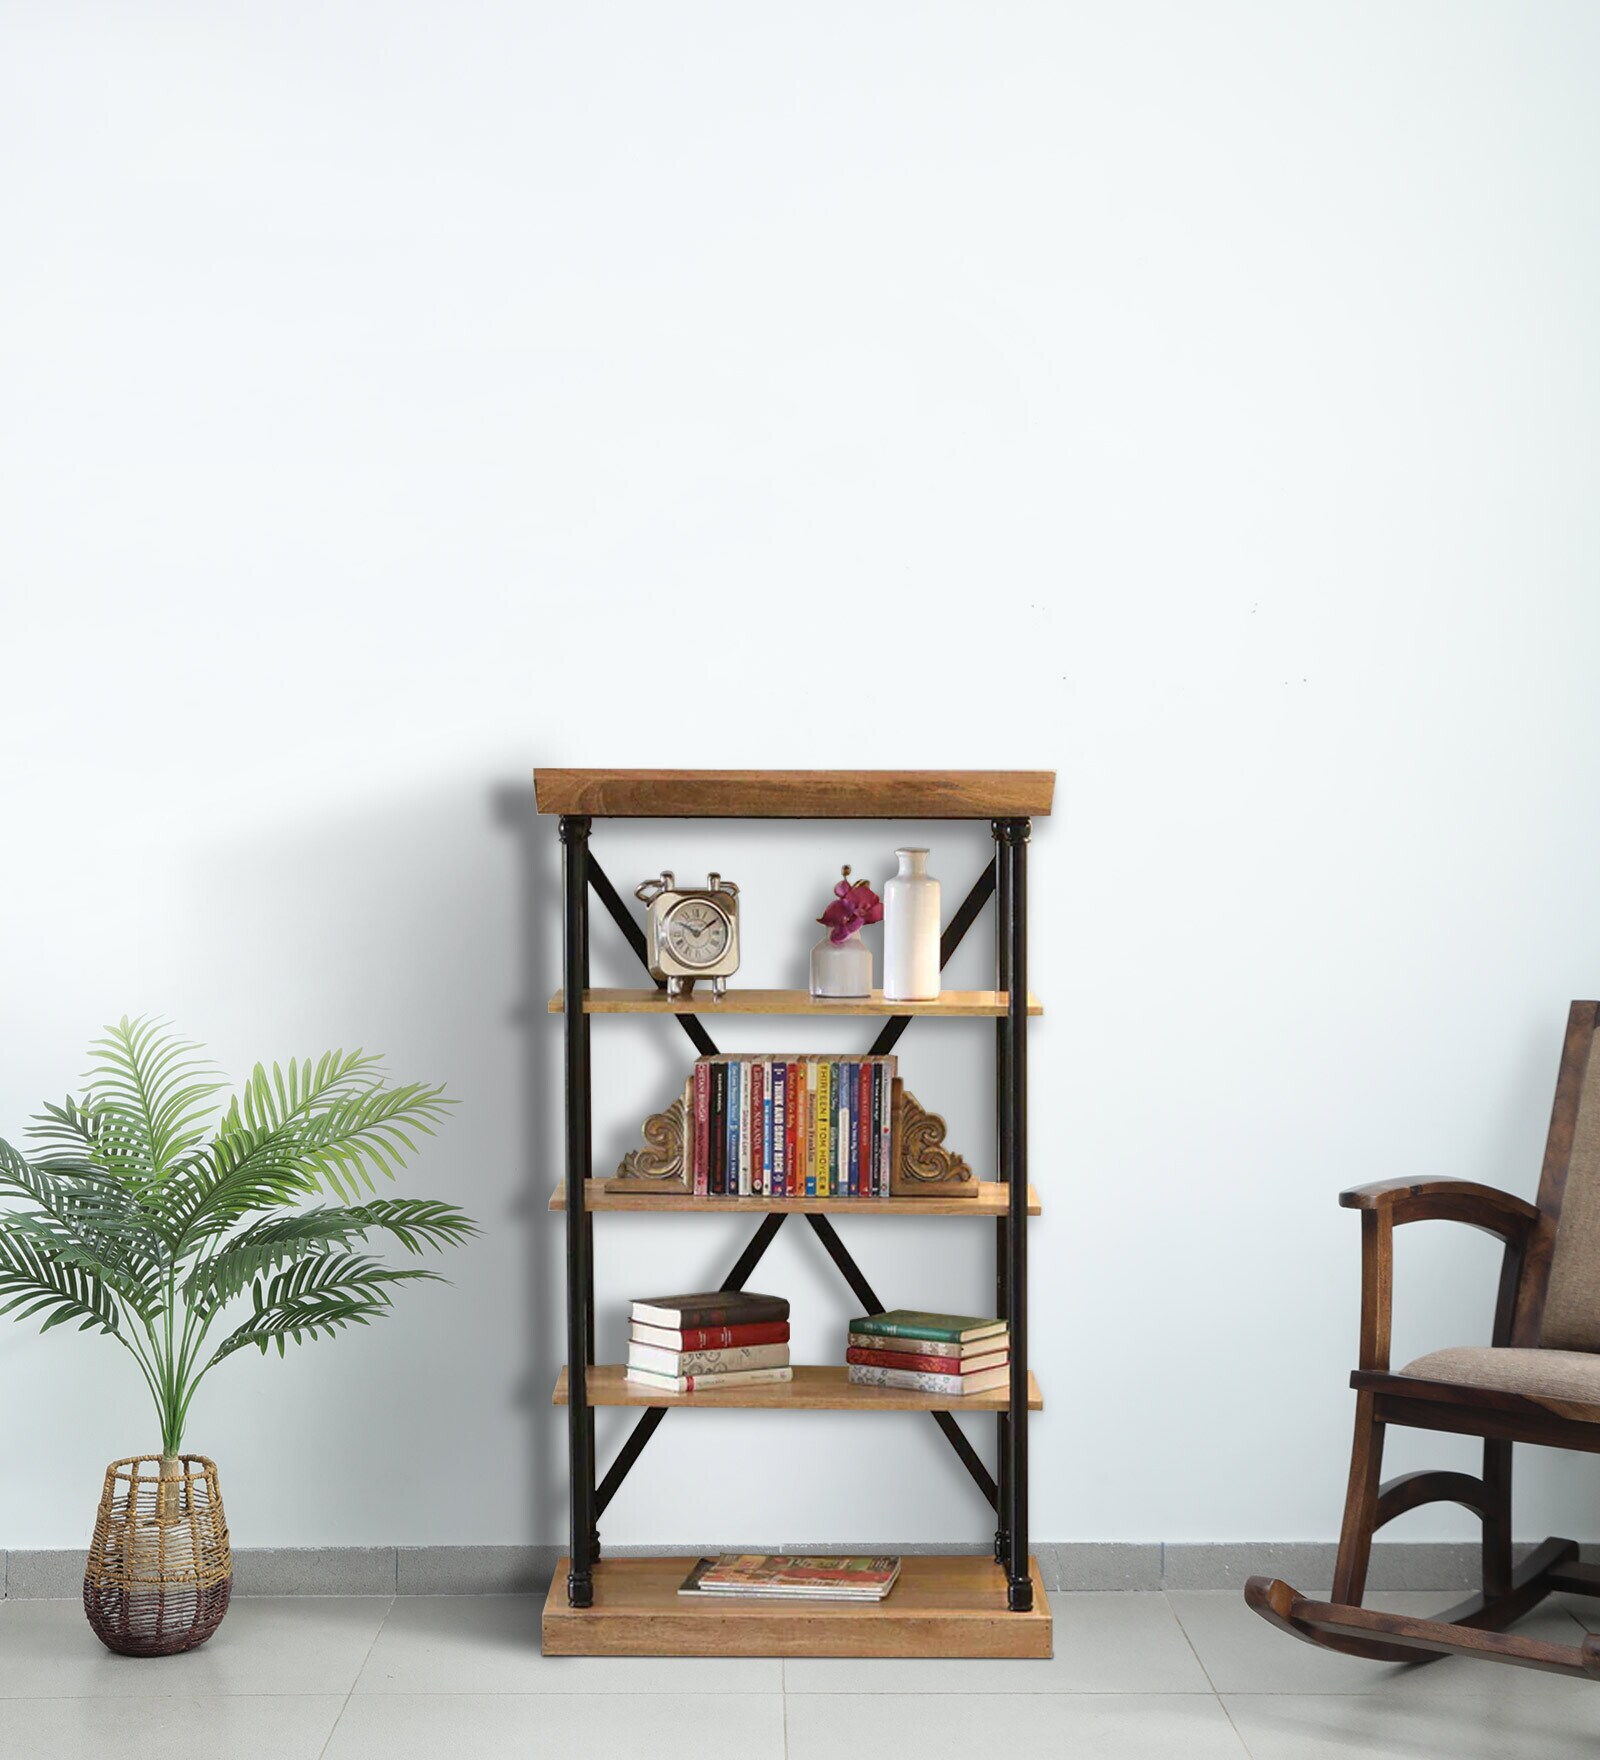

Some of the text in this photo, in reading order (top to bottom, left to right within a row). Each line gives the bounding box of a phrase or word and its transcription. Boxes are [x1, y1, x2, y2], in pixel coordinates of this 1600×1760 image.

[774, 1080, 784, 1106] THINK
[774, 1106, 784, 1124] AND
[754, 1111, 762, 1150] NALANDA
[774, 1125, 784, 1151] GROW
[774, 1152, 784, 1172] RICH
